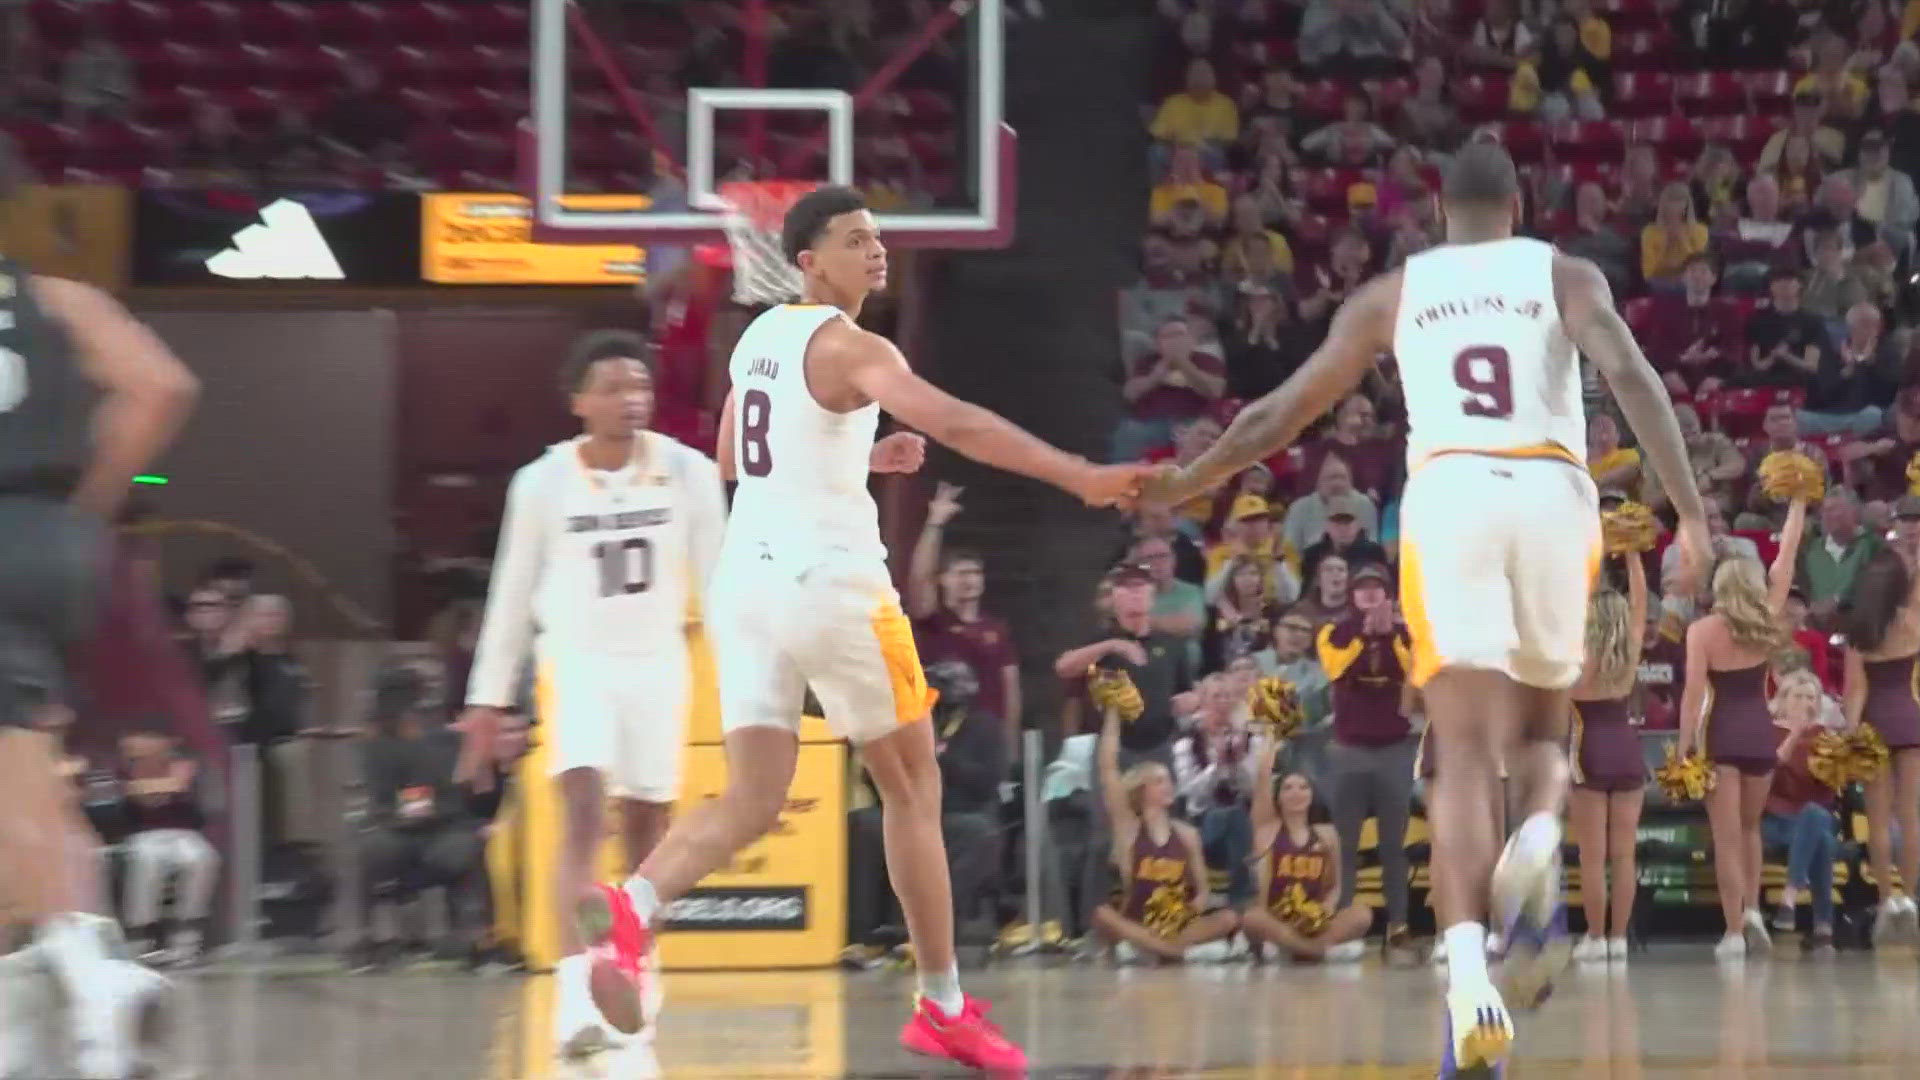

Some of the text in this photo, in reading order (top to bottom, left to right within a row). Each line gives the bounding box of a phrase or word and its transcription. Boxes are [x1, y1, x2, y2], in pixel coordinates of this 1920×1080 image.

[1452, 345, 1514, 419] 9
[741, 388, 773, 477] 8
[591, 537, 656, 598] 10
[1277, 854, 1324, 880] ASU
